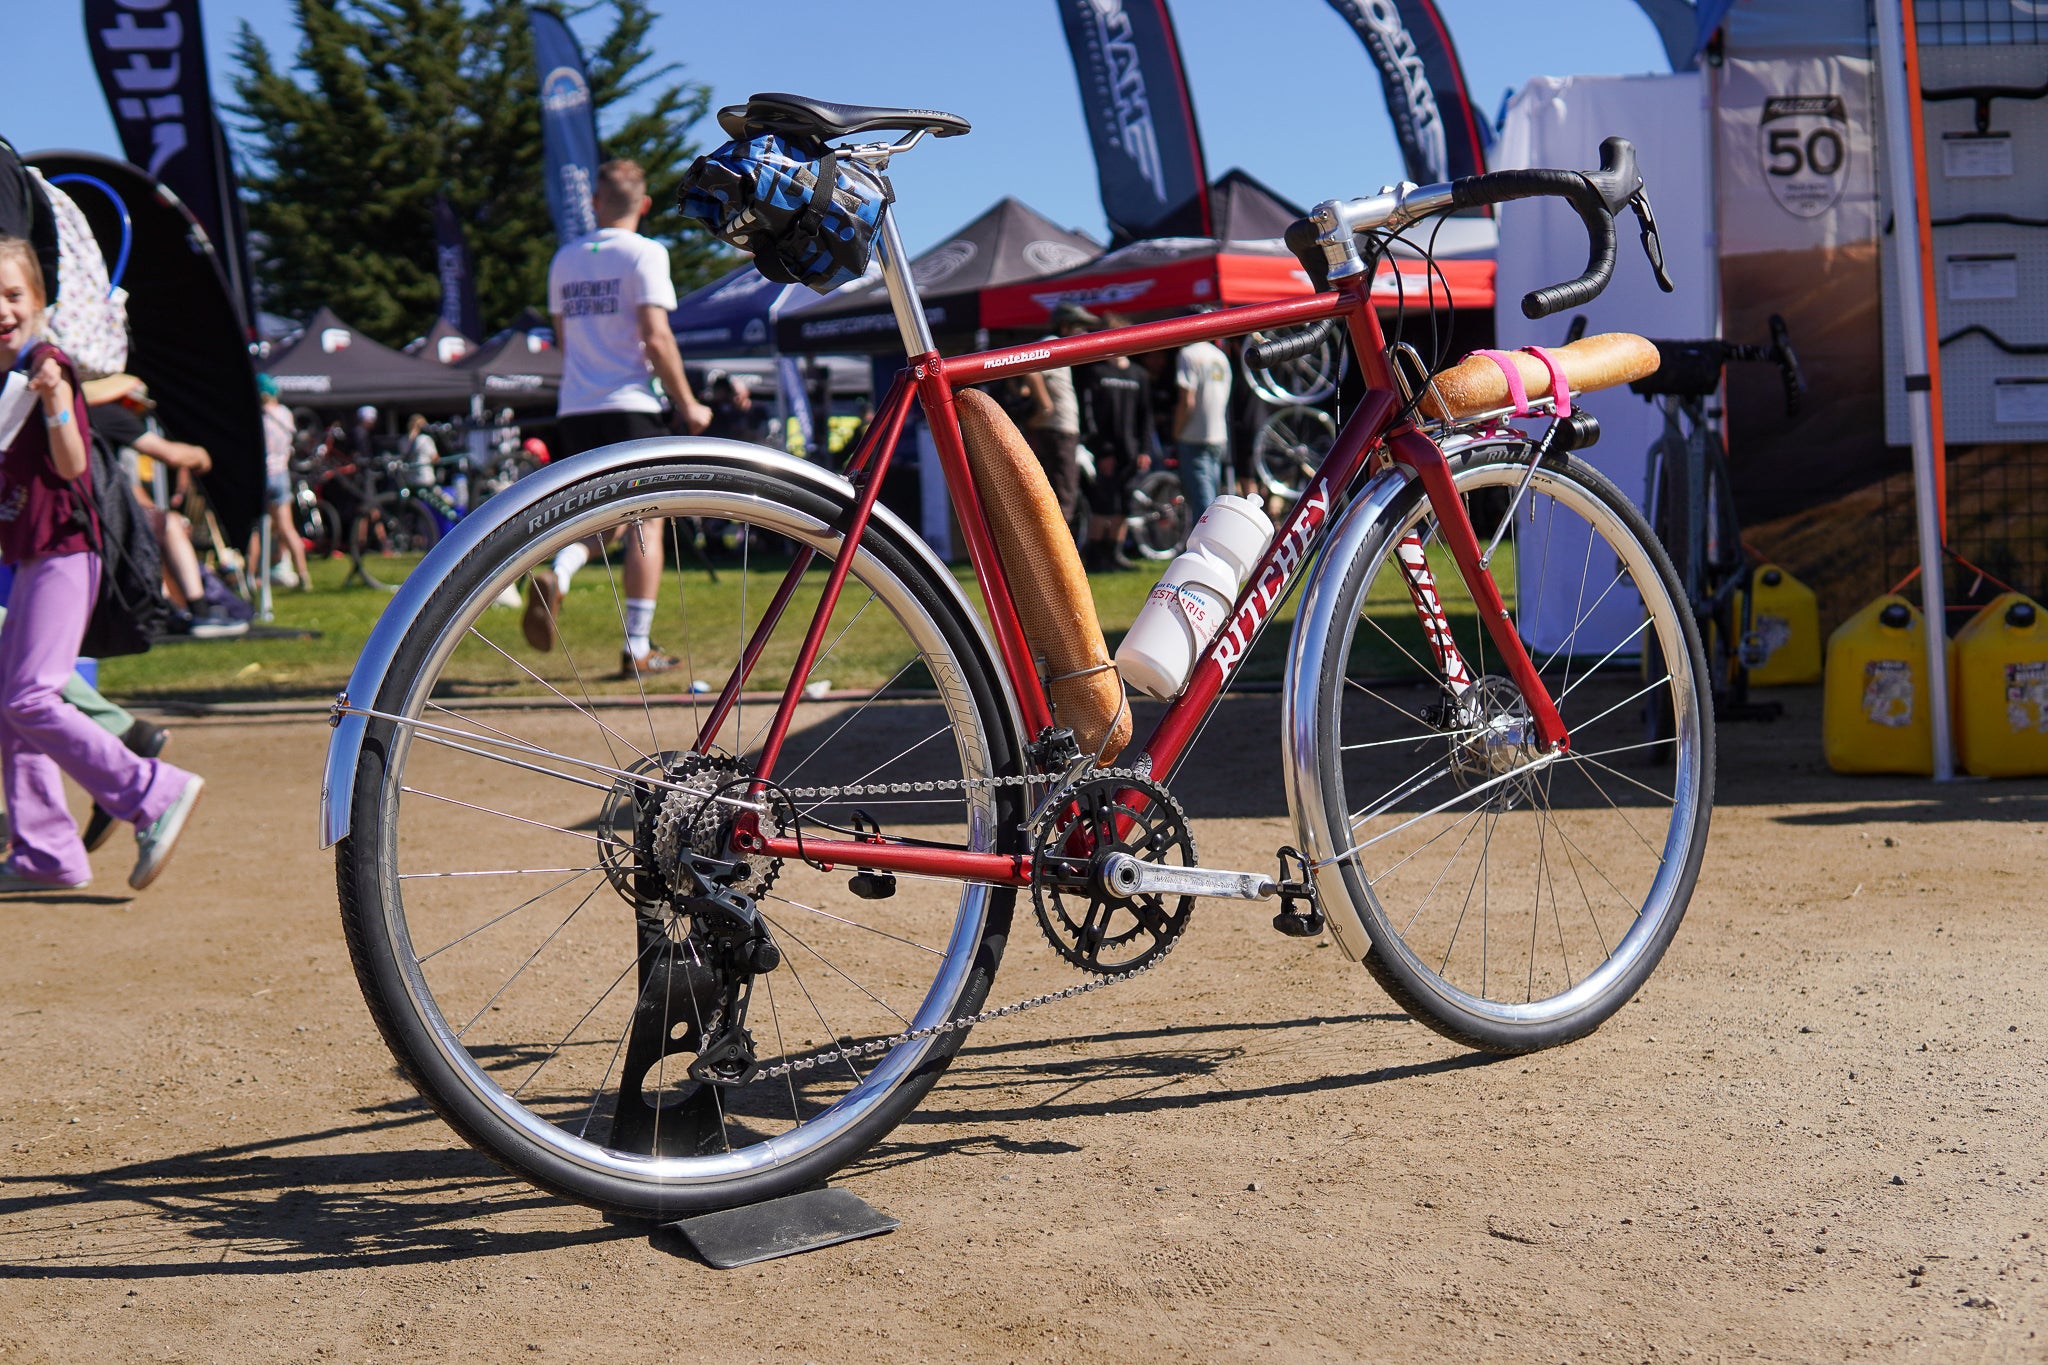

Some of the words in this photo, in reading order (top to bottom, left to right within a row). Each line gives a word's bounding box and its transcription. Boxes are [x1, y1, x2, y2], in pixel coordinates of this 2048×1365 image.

[100, 0, 187, 179] vitt
[1767, 127, 1845, 177] 50
[983, 348, 1051, 369] montebello
[528, 480, 624, 534] RITCHEY
[651, 473, 692, 483] ALPINE
[619, 505, 660, 519] ZETA
[1211, 476, 1330, 687] RITCHEY
